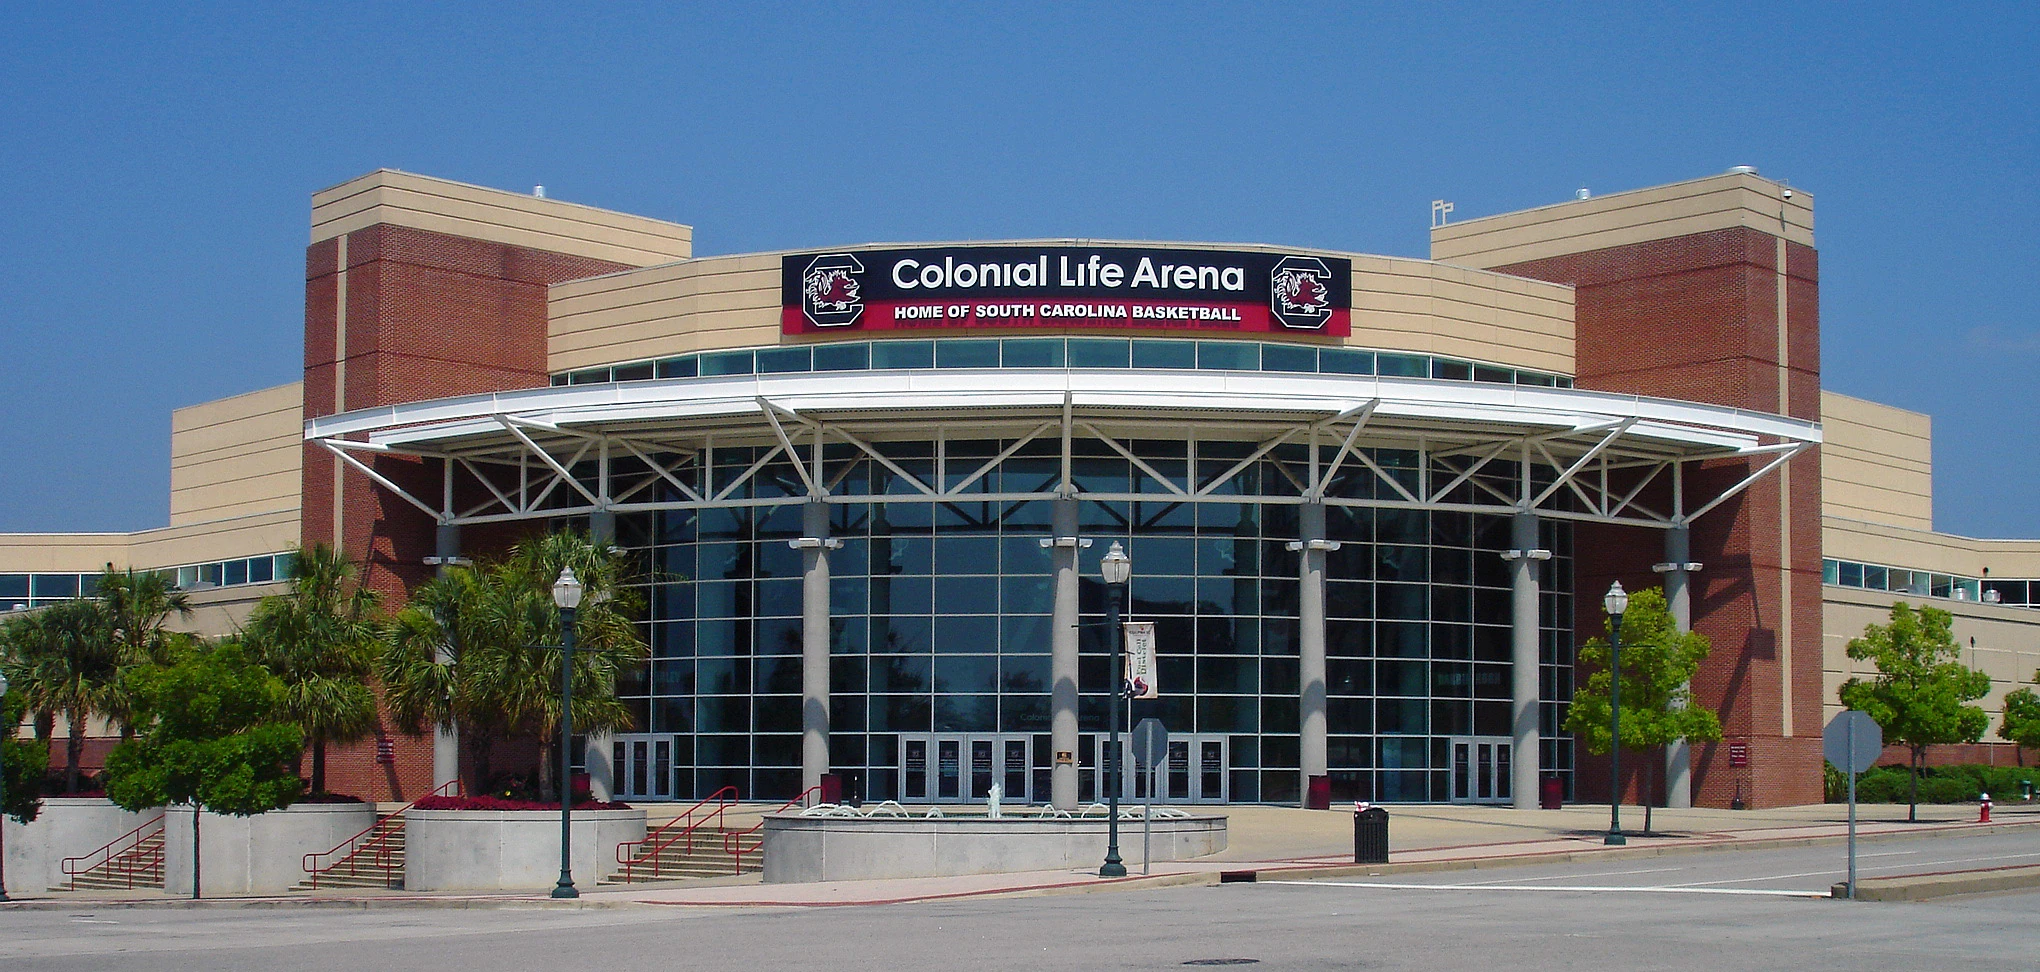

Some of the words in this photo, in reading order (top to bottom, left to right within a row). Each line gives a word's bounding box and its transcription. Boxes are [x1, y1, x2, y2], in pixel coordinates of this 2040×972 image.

[892, 255, 1048, 289] Colonial
[1060, 254, 1124, 288] Life
[1130, 256, 1245, 291] Arena
[894, 305, 943, 319] HOME
[947, 305, 970, 319] OF
[975, 304, 1035, 318] SOUTH
[1039, 304, 1127, 318] CAROLINA
[1132, 305, 1242, 321] BASKETBALL
